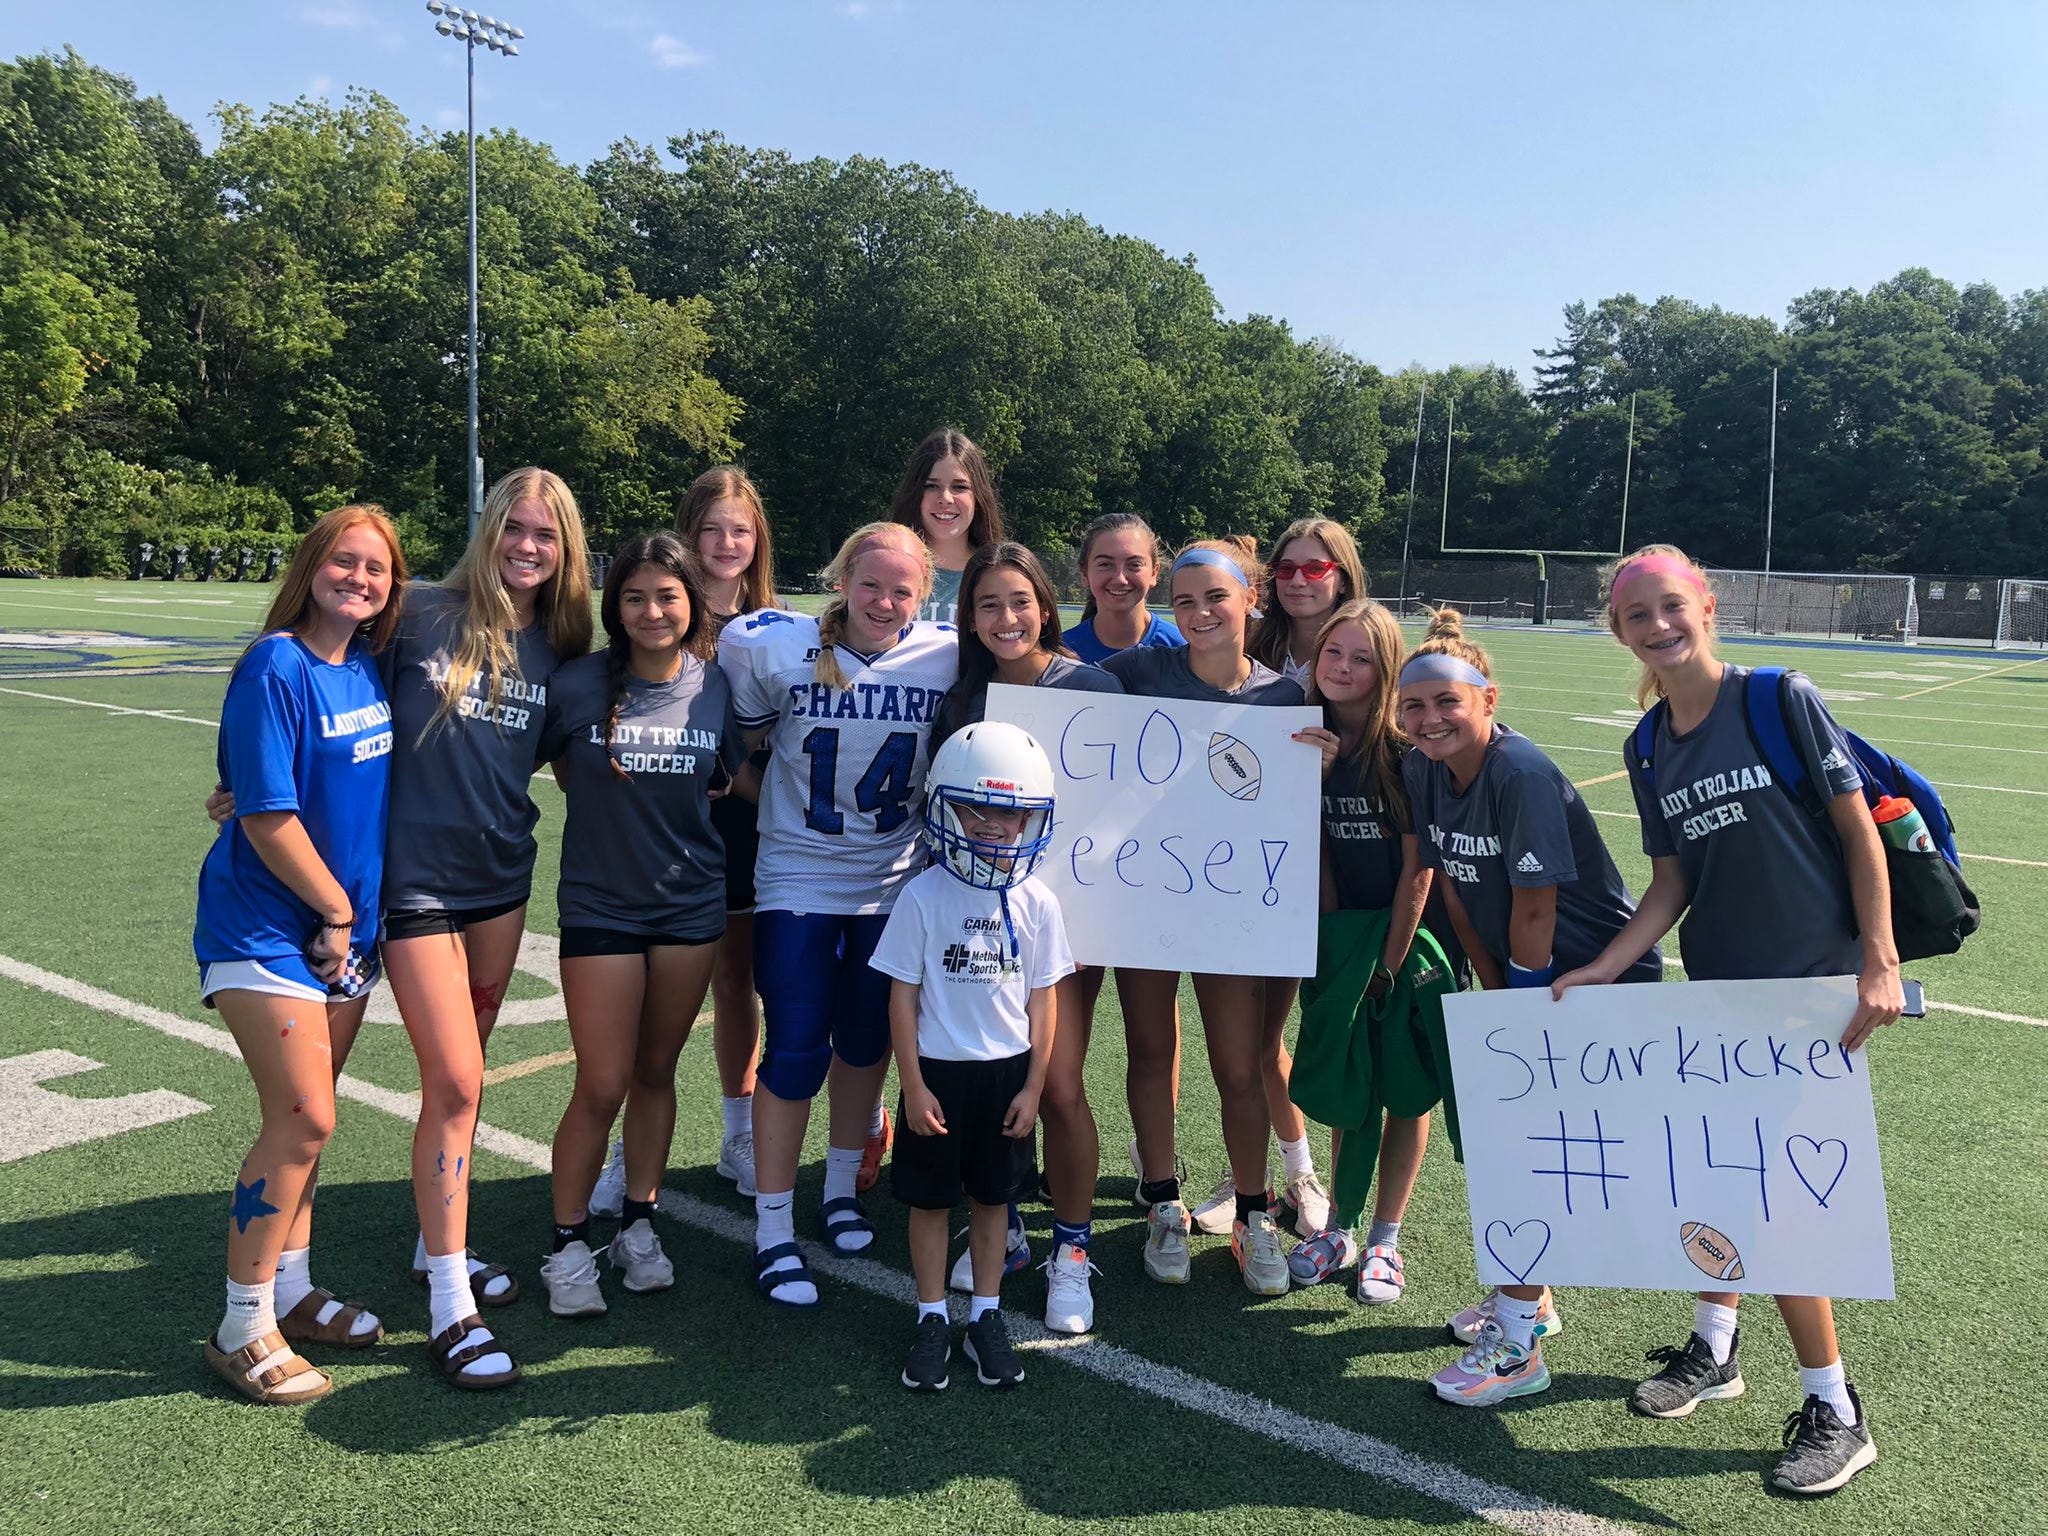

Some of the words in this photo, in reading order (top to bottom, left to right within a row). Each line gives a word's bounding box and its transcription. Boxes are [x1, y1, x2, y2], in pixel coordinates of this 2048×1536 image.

[353, 730, 394, 764] SOCCER
[649, 726, 717, 751] TROJAN
[1059, 705, 1183, 785] GO
[620, 752, 697, 775] SOCCER
[801, 726, 919, 835] 14
[986, 779, 1015, 791] Riddell
[1660, 787, 1693, 820] ADY
[1692, 764, 1773, 803] TROJAN
[1682, 801, 1749, 841] SOCER
[1069, 834, 1290, 907] eese!
[963, 918, 1002, 932] CARM
[968, 962, 999, 977] Sports
[971, 950, 999, 962] Metho
